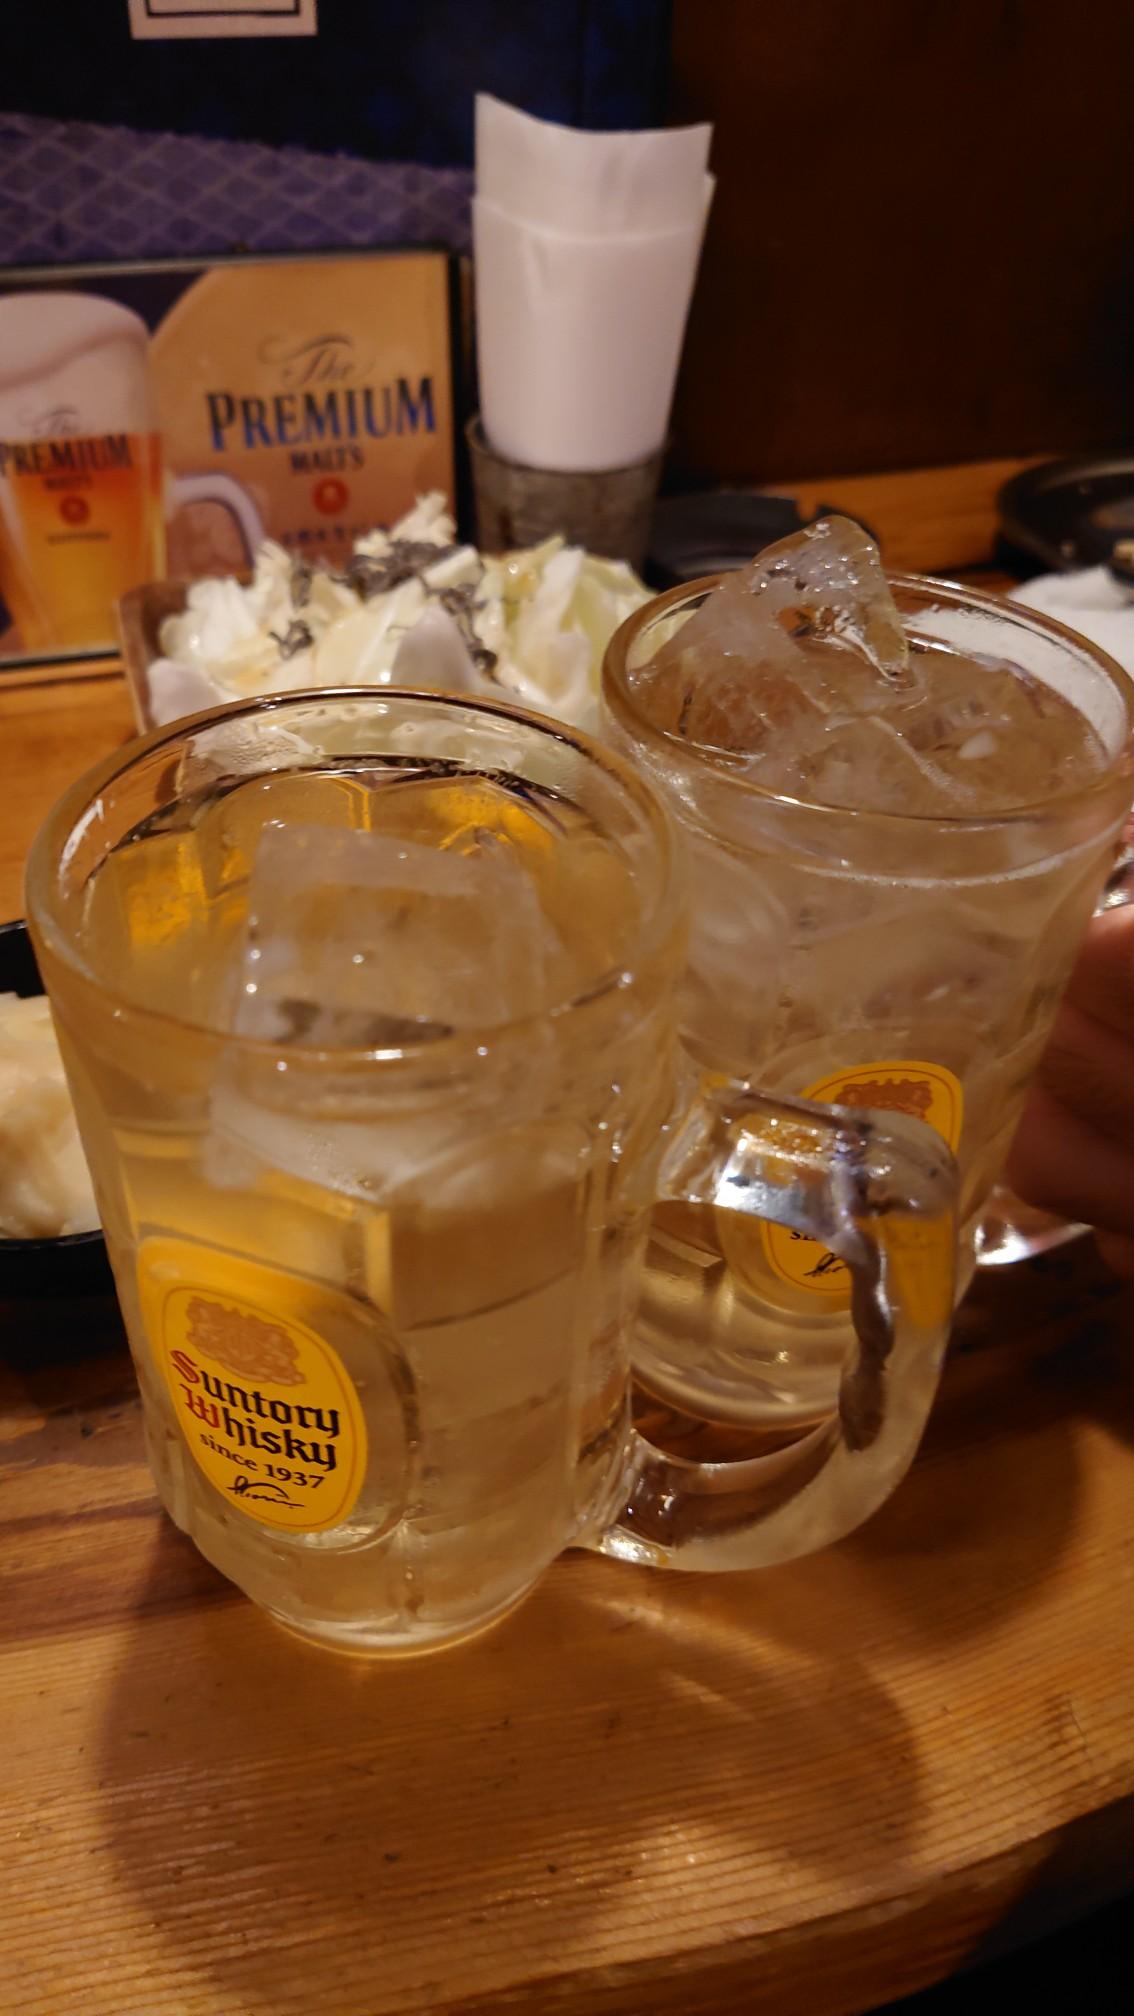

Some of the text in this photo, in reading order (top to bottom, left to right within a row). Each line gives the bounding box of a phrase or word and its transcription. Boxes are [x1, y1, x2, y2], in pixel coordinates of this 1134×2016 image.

[258, 333, 374, 386] The
[205, 374, 437, 453] PREMIUM
[169, 1350, 340, 1439] Suntory
[180, 1383, 338, 1473] Whisky
[200, 1431, 326, 1490] since 1937
